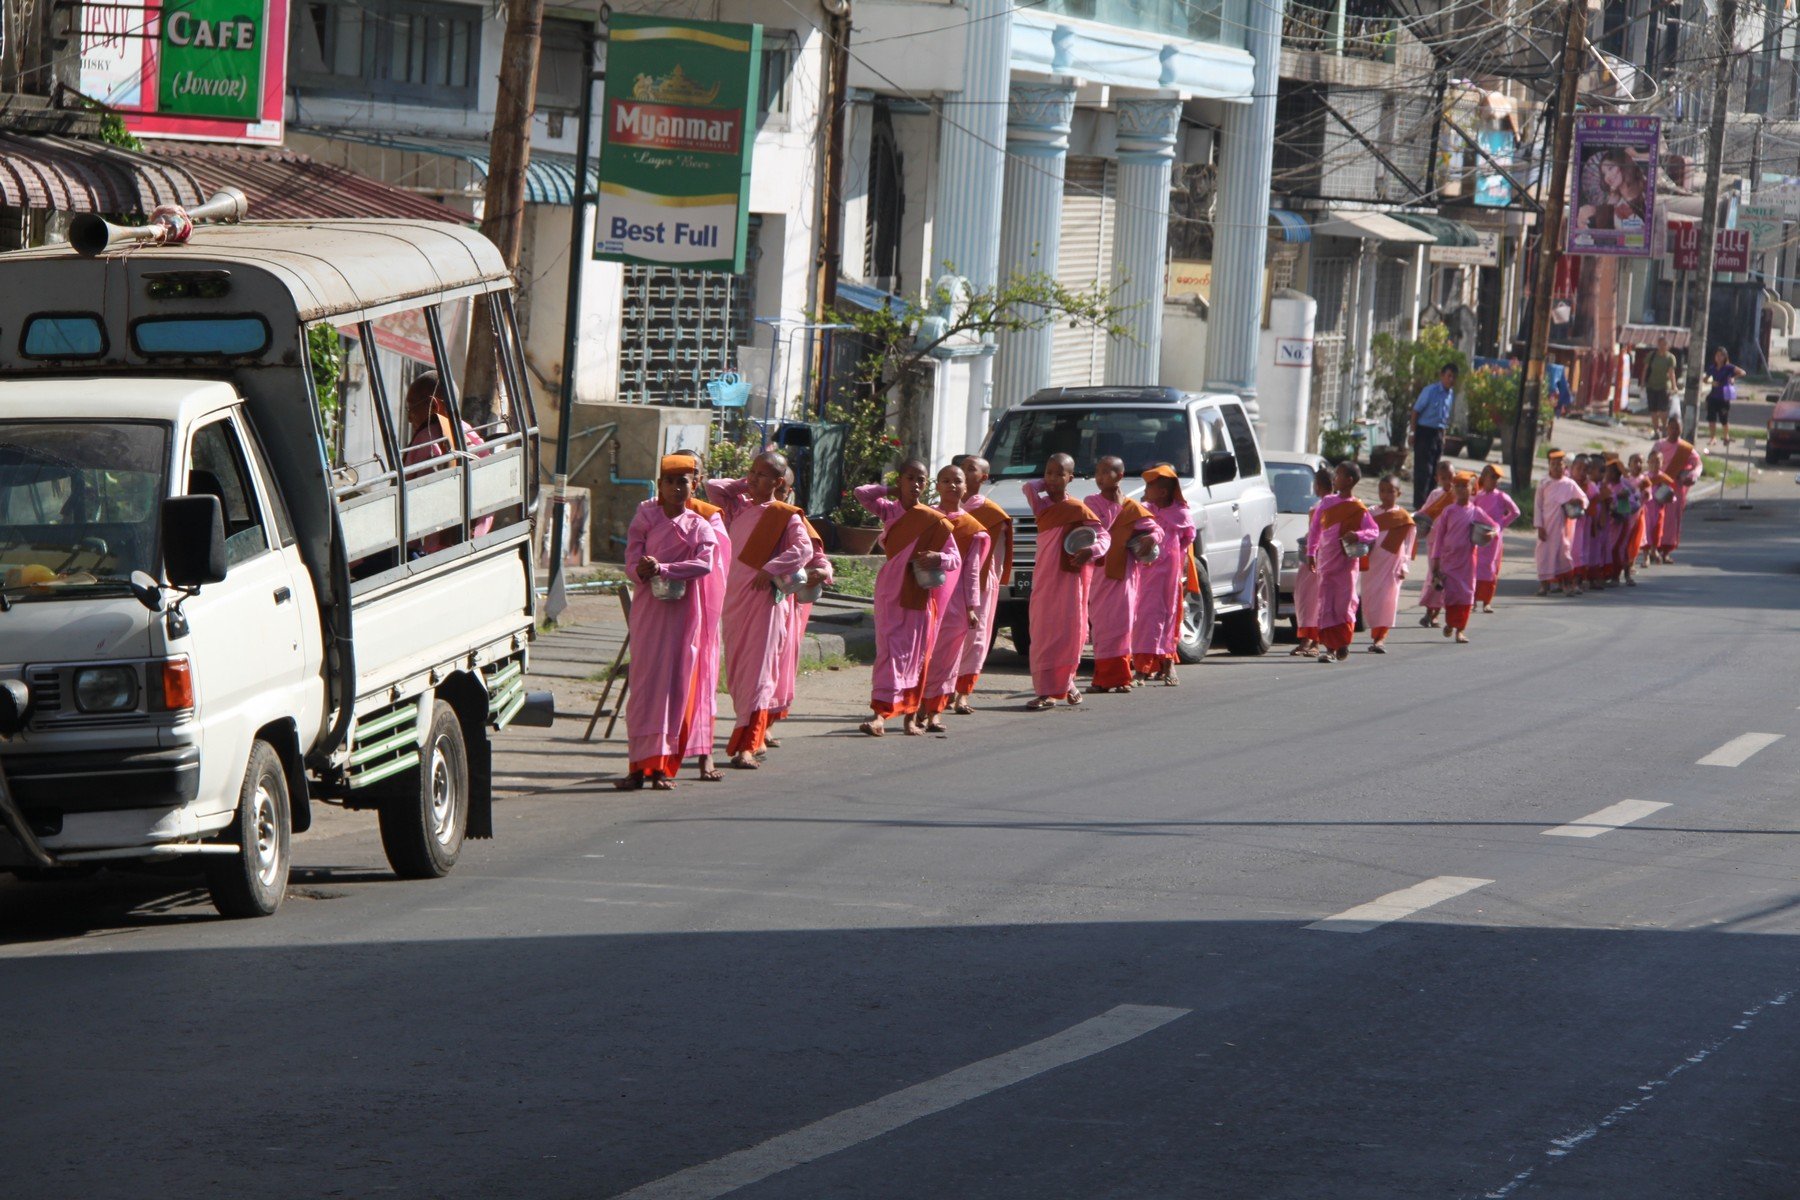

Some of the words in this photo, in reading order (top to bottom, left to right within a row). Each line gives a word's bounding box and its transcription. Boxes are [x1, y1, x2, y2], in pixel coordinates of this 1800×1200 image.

[167, 11, 254, 49] CAFE
[172, 71, 247, 101] (JUNIOR)
[616, 105, 733, 142] Myanmar
[611, 216, 665, 244] Best
[674, 222, 718, 247] Full
